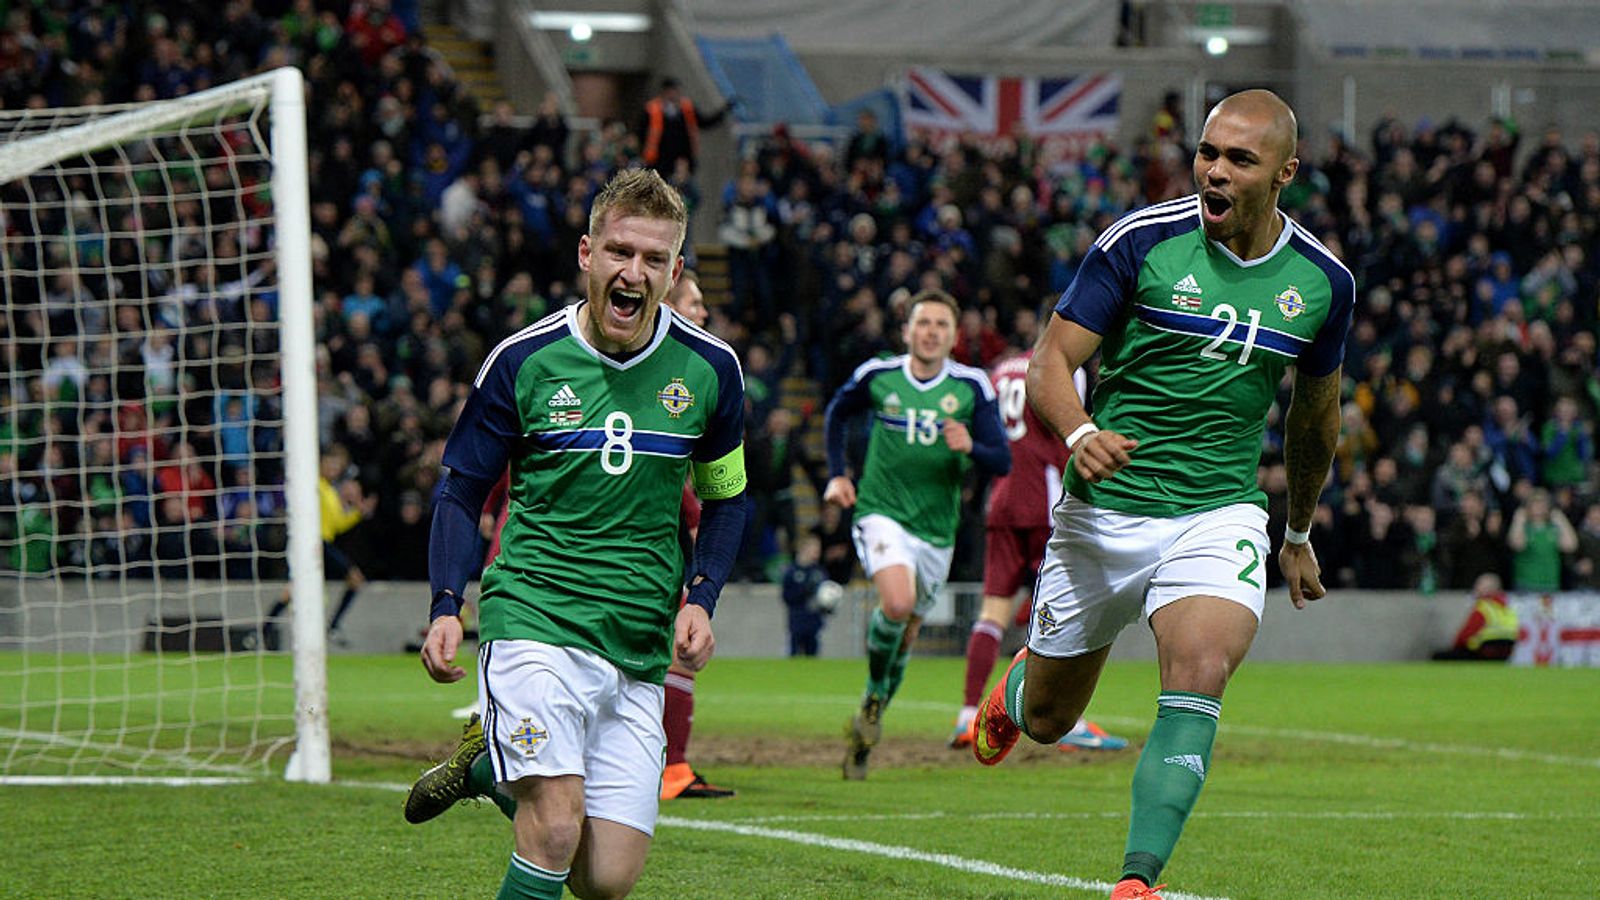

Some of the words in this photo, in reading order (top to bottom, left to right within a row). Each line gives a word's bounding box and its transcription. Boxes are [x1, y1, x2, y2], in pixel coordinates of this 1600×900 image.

[1173, 283, 1202, 295] adidas
[1200, 303, 1262, 365] 21
[548, 396, 582, 407] adidas
[997, 377, 1028, 441] 19
[601, 411, 633, 475] 8
[906, 408, 938, 446] 13
[1236, 539, 1260, 589] 2
